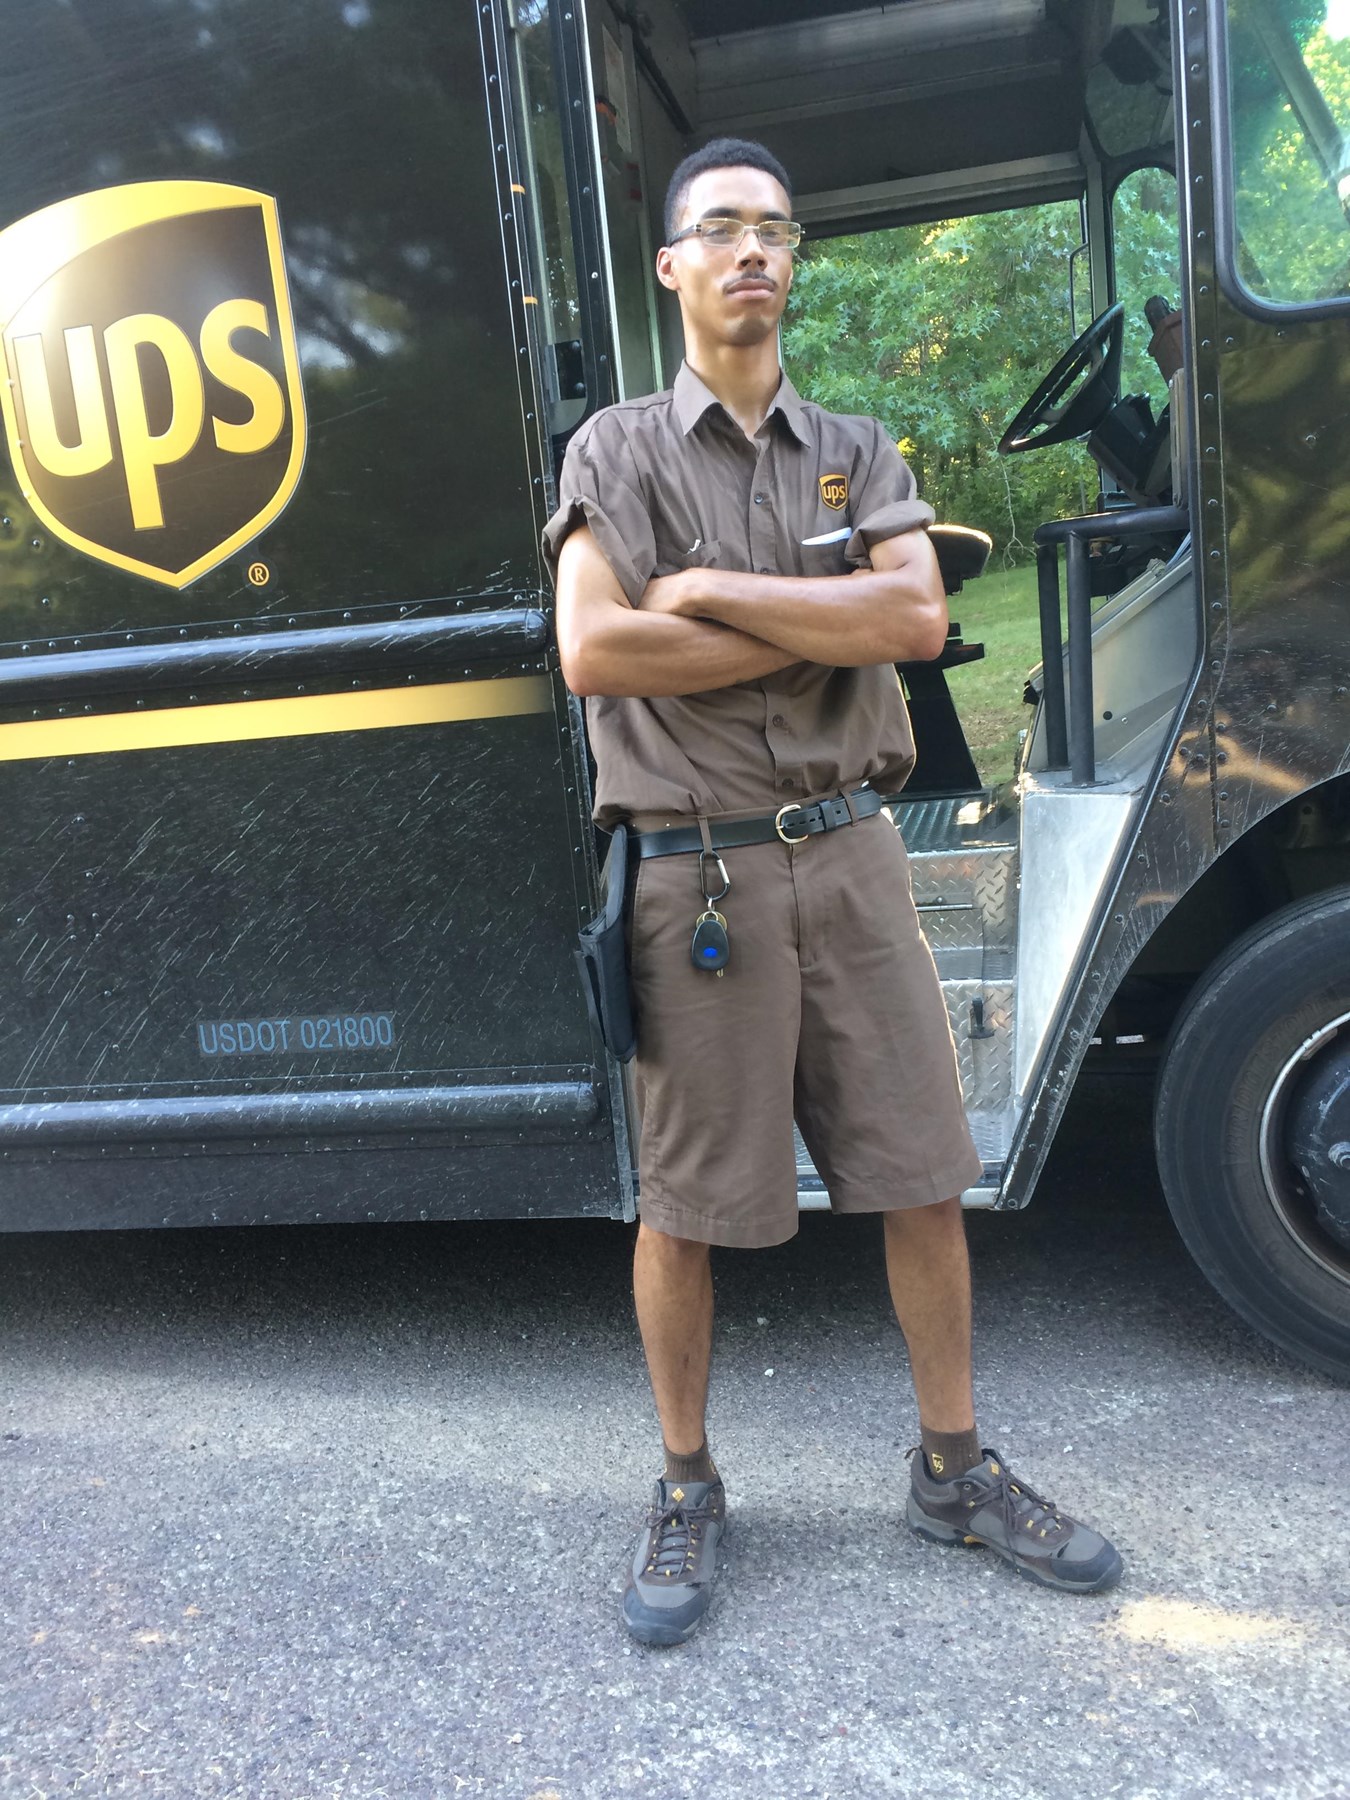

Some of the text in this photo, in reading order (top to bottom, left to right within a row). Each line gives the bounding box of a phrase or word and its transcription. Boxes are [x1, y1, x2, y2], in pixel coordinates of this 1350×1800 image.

[13, 299, 284, 530] ups
[823, 485, 846, 504] ups
[200, 1016, 392, 1054] USDOT 021800
